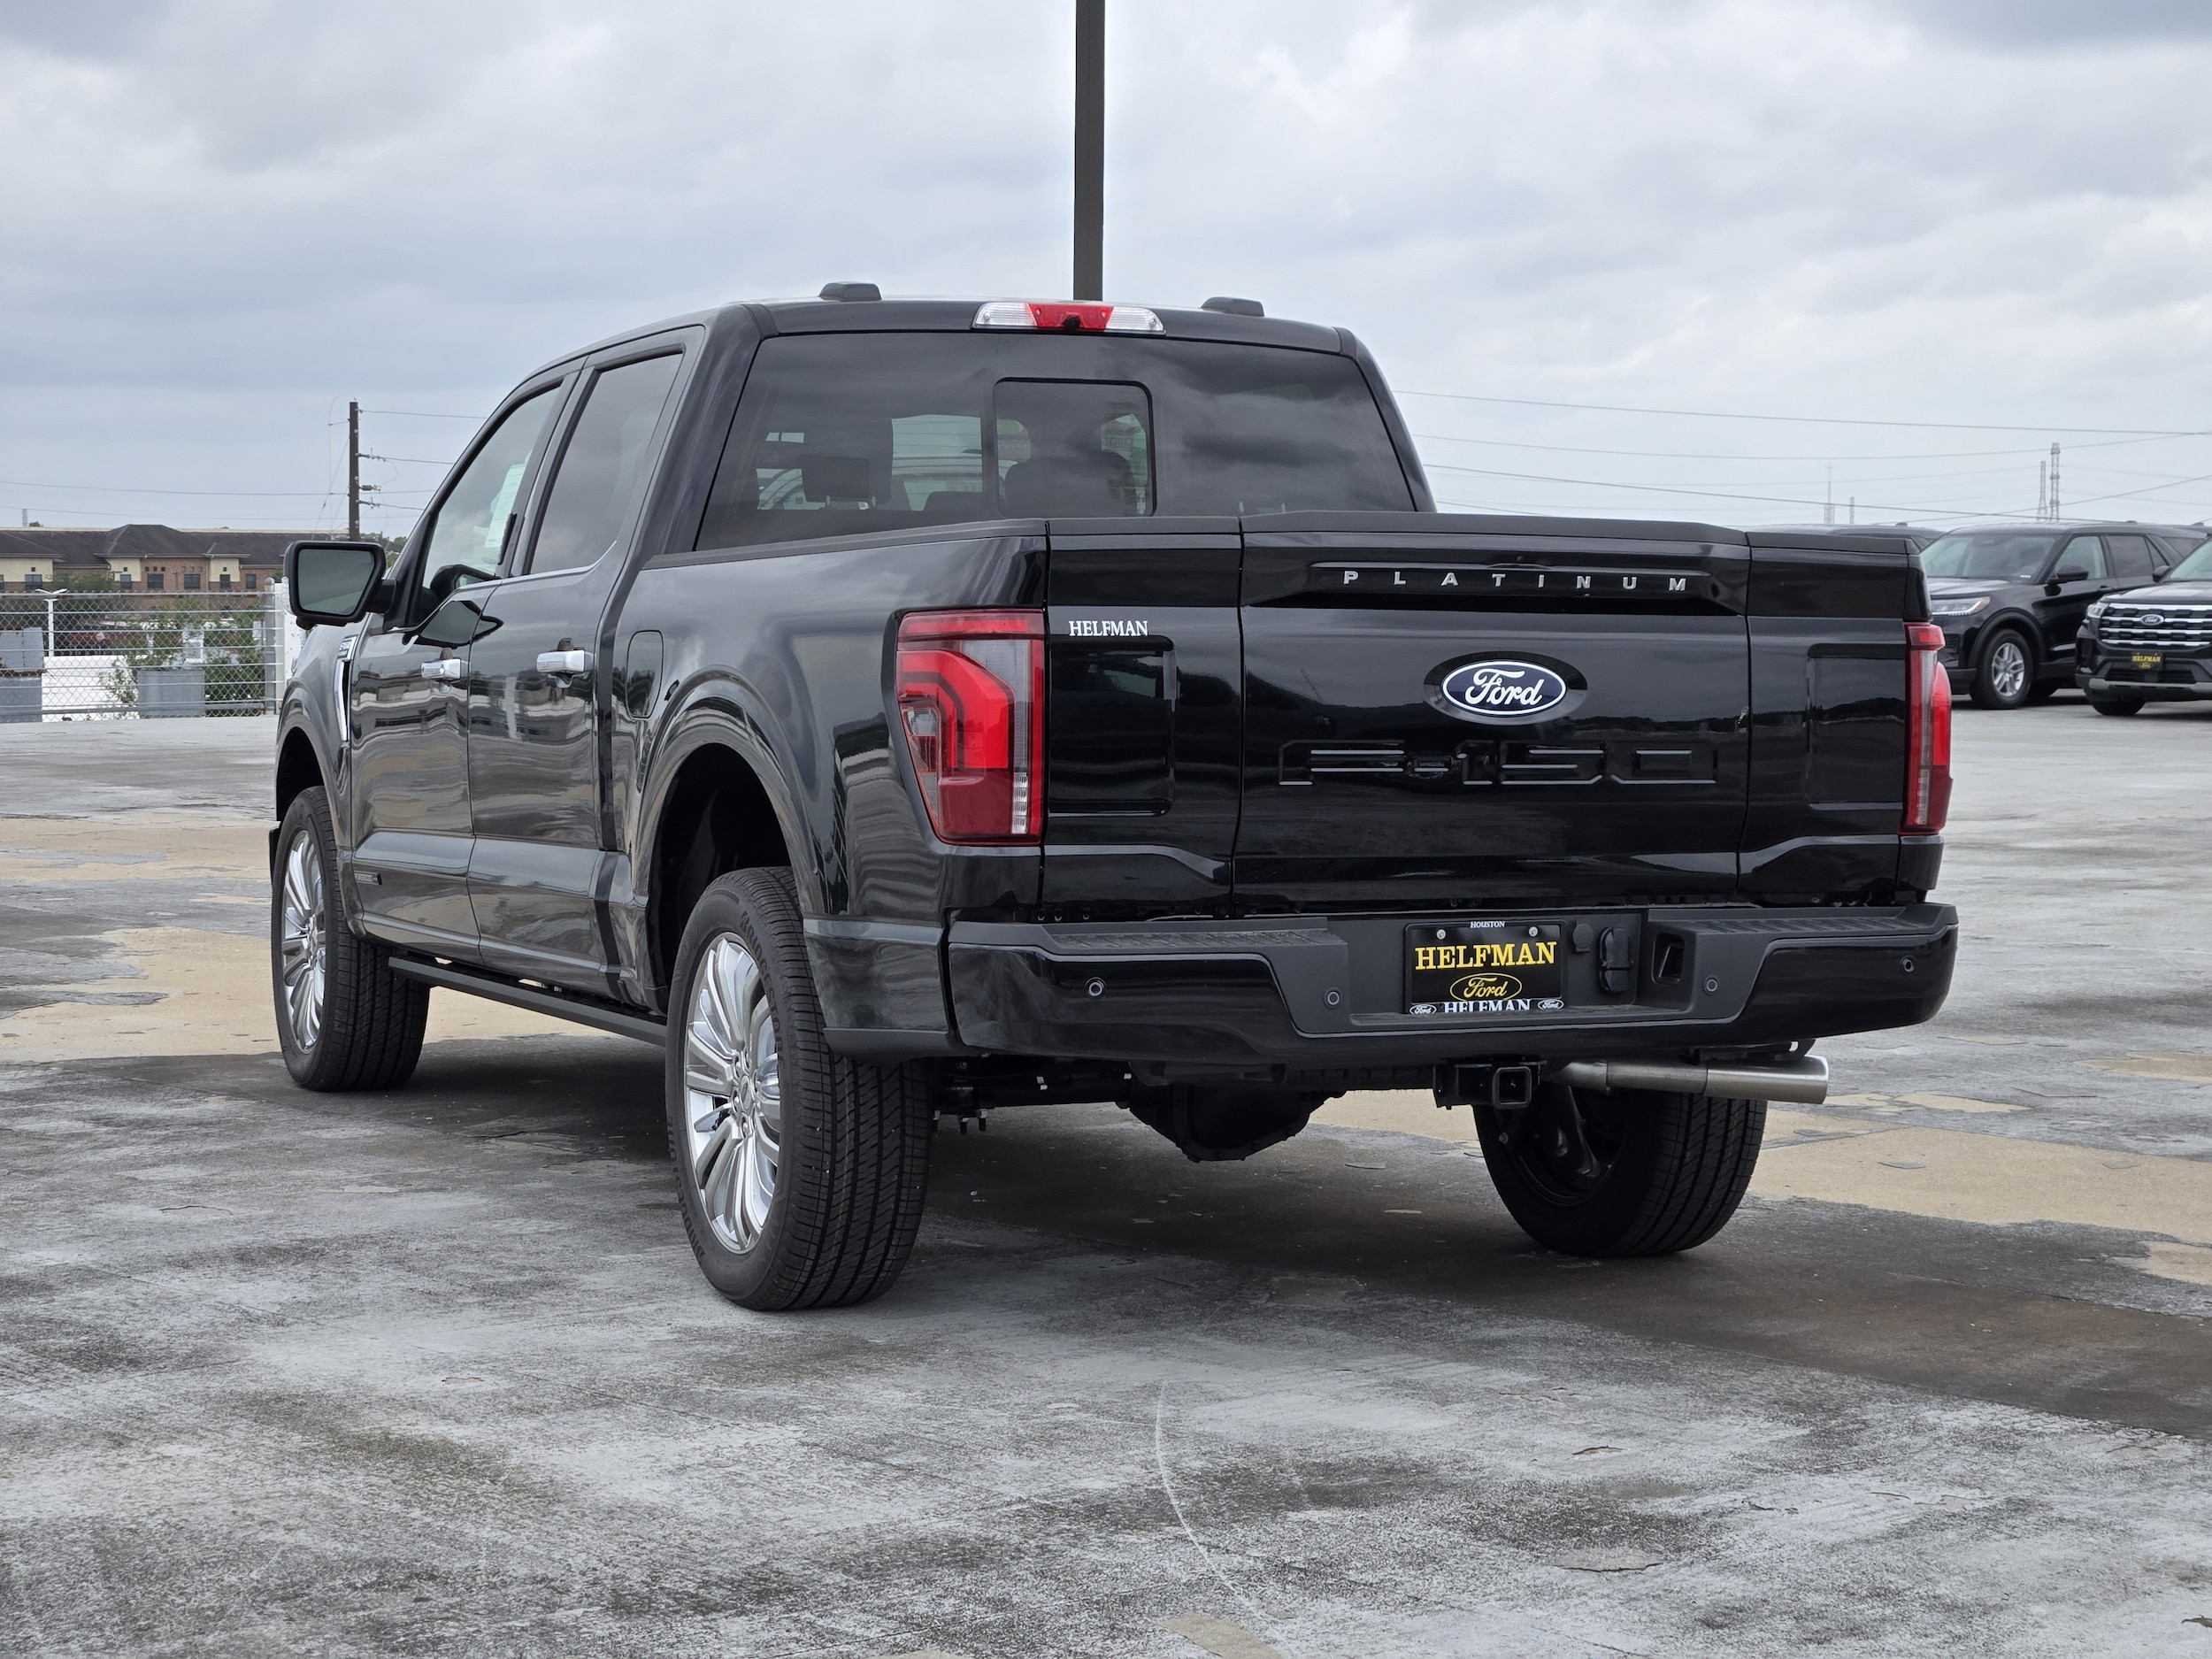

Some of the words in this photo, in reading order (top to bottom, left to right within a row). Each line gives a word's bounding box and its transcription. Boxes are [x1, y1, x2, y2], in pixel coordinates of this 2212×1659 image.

[1343, 569, 1687, 592] PLATINUM
[1068, 620, 1148, 637] HELFMAN
[1463, 666, 1546, 707] Ford
[1279, 739, 1718, 786] F-150
[1470, 920, 1505, 929] HOUSTON
[1415, 941, 1557, 971] HELFMAN
[1463, 977, 1509, 998] Ford
[1443, 999, 1532, 1014] HELFMAN
